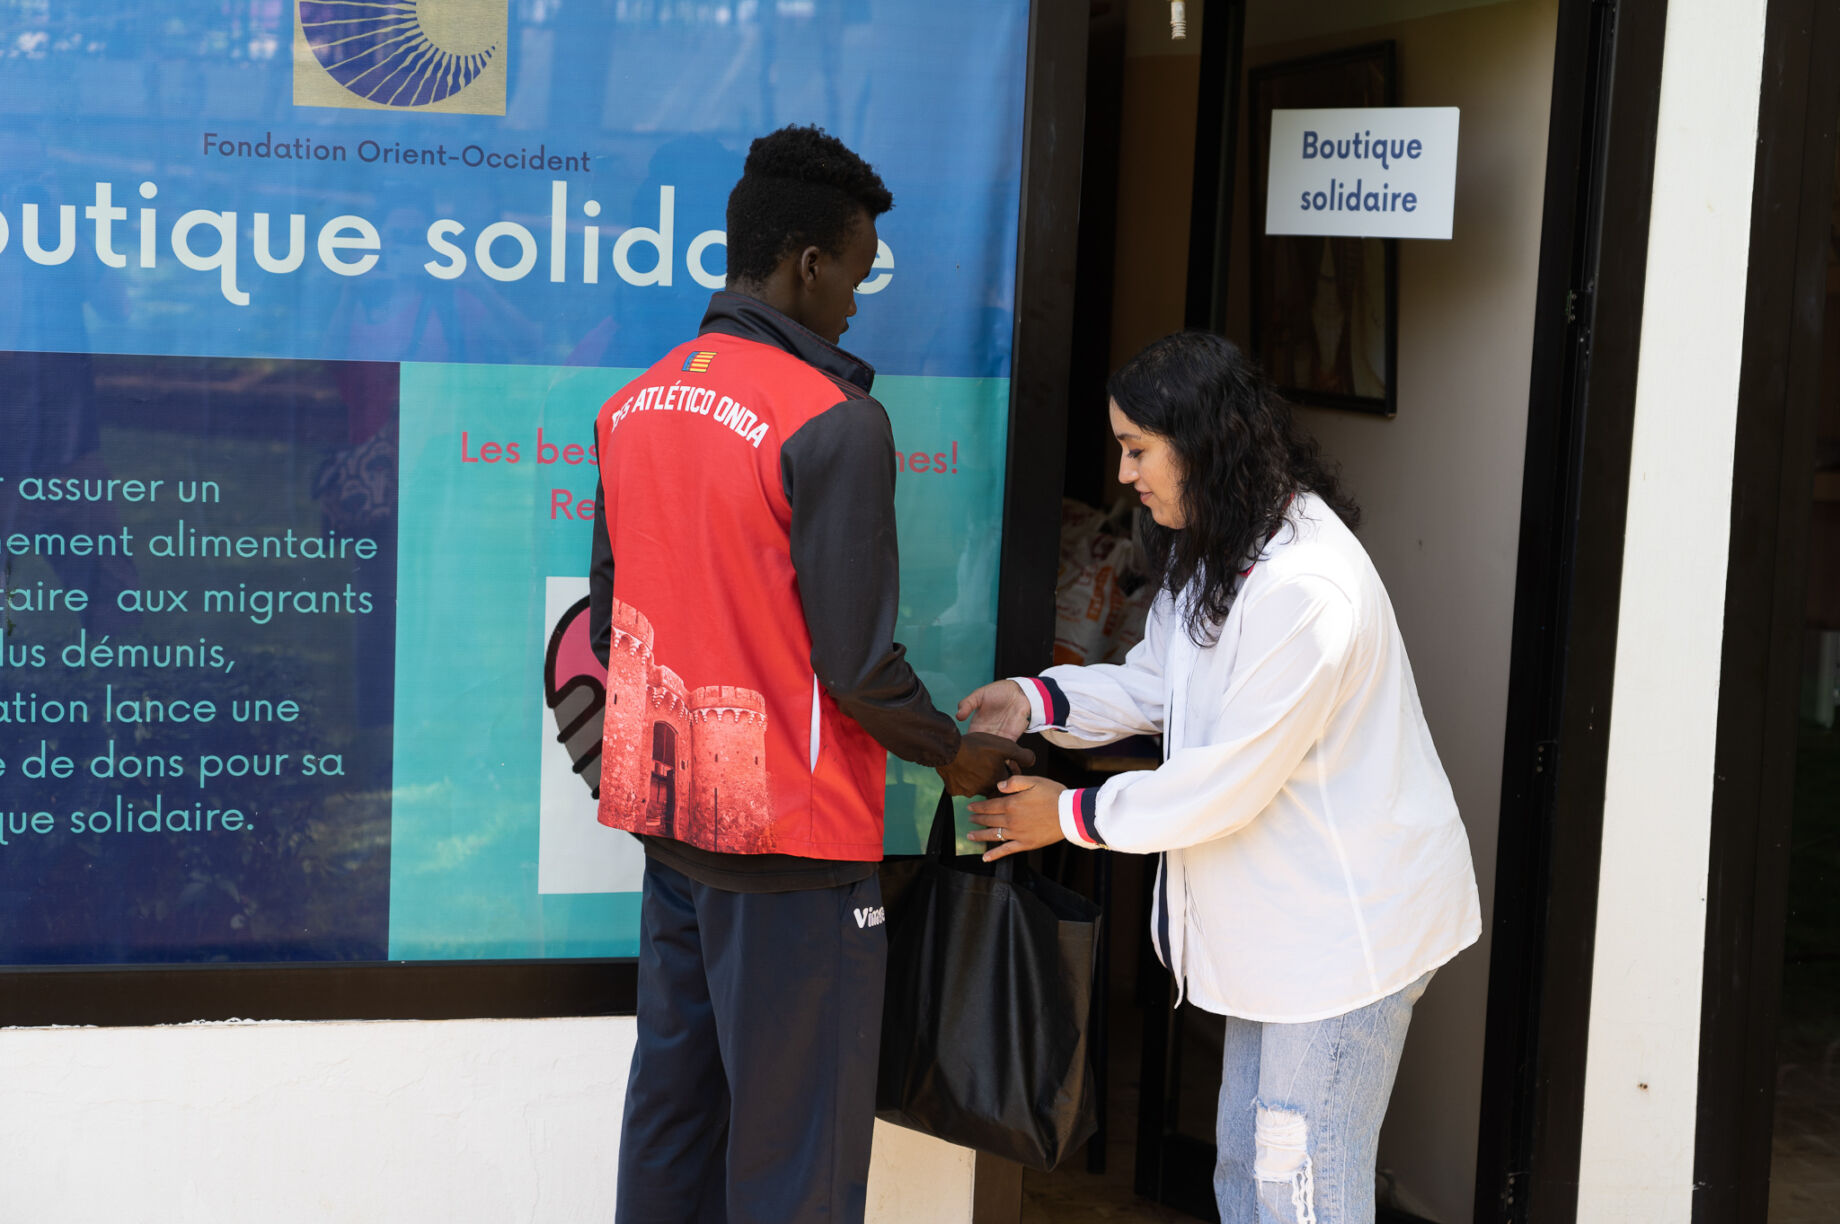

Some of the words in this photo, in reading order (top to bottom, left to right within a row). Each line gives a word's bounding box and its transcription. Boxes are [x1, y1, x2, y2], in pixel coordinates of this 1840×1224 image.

[203, 132, 347, 162] Fondation
[357, 138, 591, 172] Orient-Occident
[1302, 130, 1423, 170] Boutique
[1300, 178, 1418, 212] solidaire
[0, 181, 382, 306] utique
[631, 379, 717, 415] ATLÉTICO
[713, 396, 769, 449] ONDA
[461, 431, 521, 464] Les
[18, 477, 164, 502] assurer
[178, 480, 220, 503] un
[0, 526, 134, 557] ement
[148, 519, 378, 560] alimentaire
[117, 588, 188, 613] aux
[204, 583, 373, 625] migrants
[61, 628, 236, 674] démunis,
[106, 684, 217, 723] lance
[232, 700, 300, 722] une
[22, 739, 74, 779] de
[90, 739, 184, 778] dons
[199, 754, 289, 789] pour
[302, 754, 345, 776] sa
[70, 794, 255, 834] solidaire.
